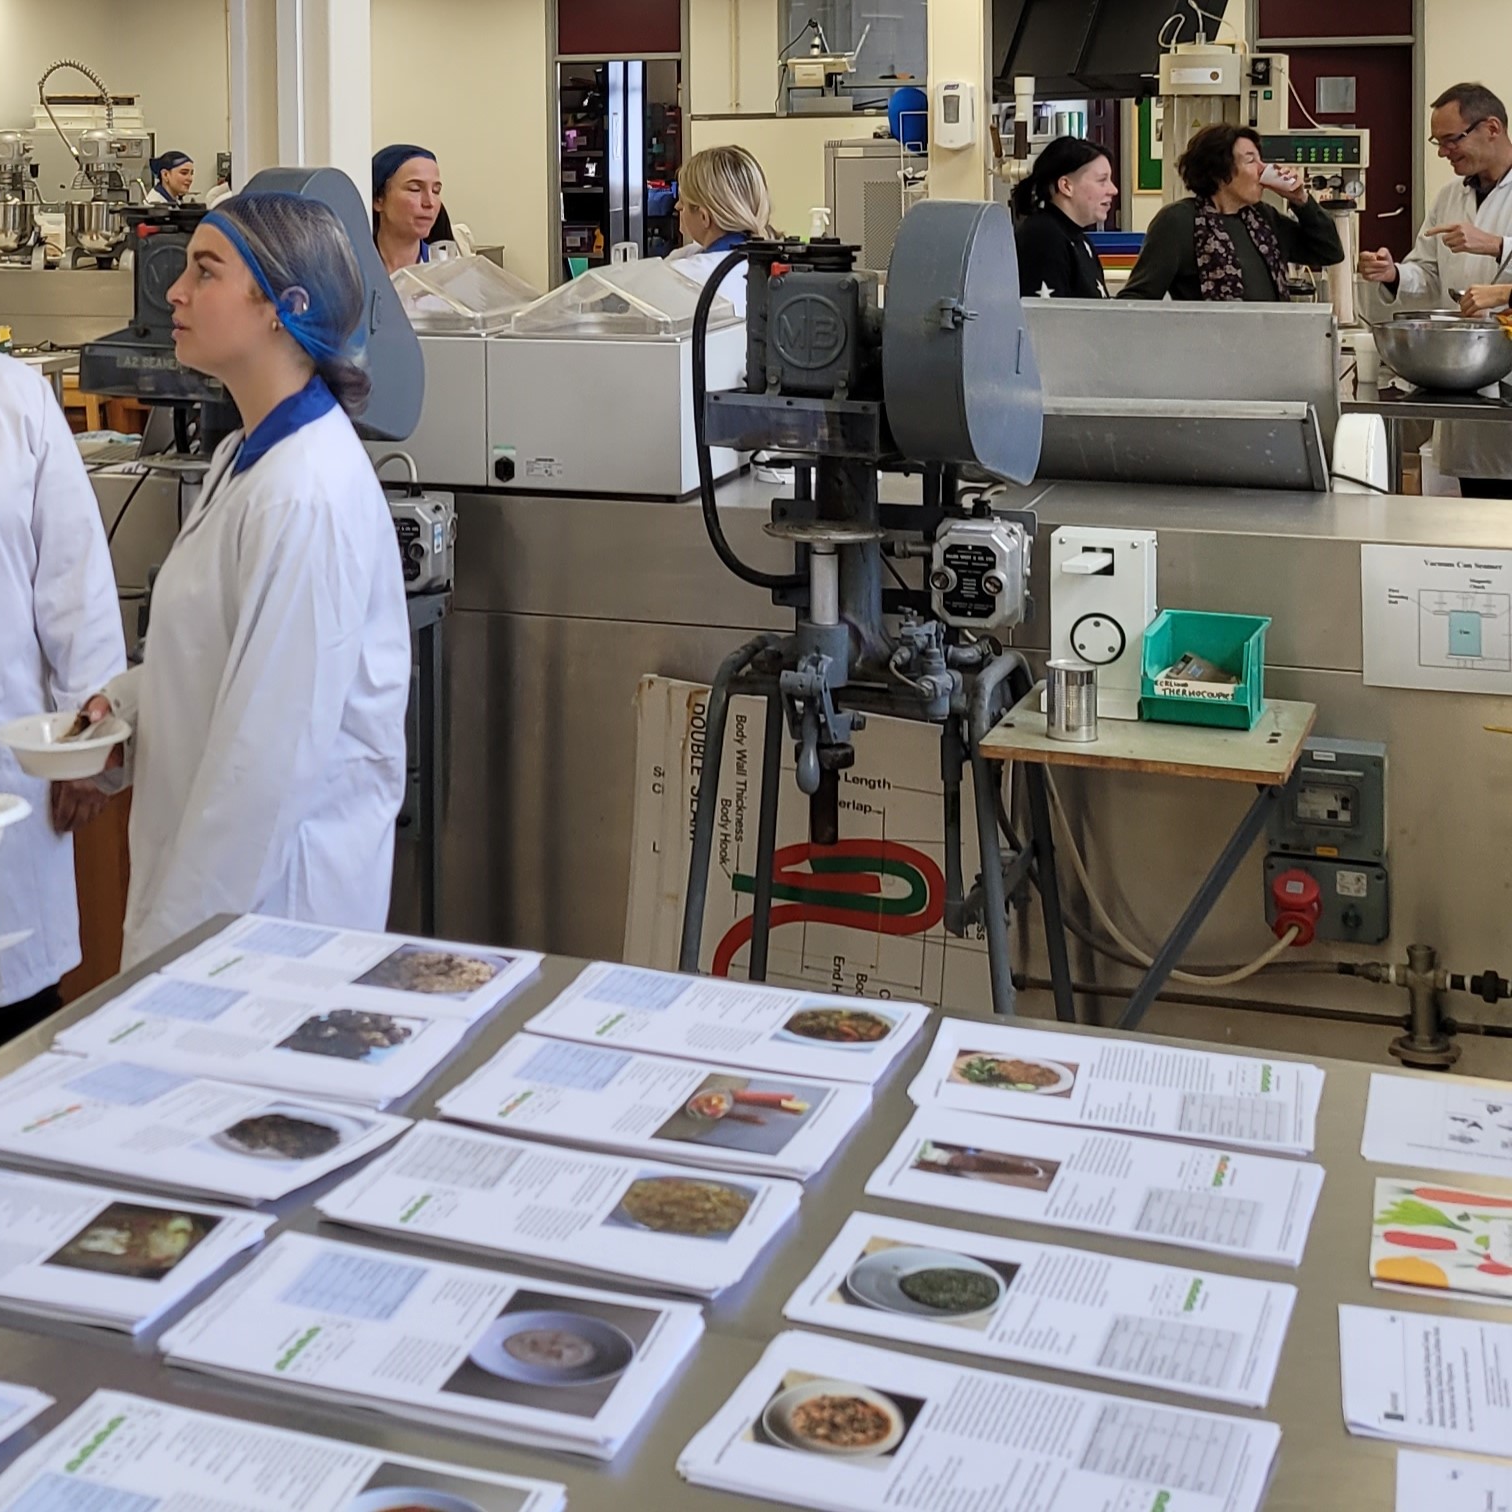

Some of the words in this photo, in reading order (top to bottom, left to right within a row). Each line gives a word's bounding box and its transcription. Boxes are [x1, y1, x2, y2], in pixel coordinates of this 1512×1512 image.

[691, 703, 706, 776] DOUBLE
[733, 714, 747, 746] Body
[736, 749, 747, 776] Wall
[844, 771, 891, 790] Length
[718, 798, 732, 831] Body
[734, 780, 747, 842] Thickness
[838, 800, 873, 815] erlap
[719, 832, 729, 865] Hook
[832, 955, 845, 981] End
